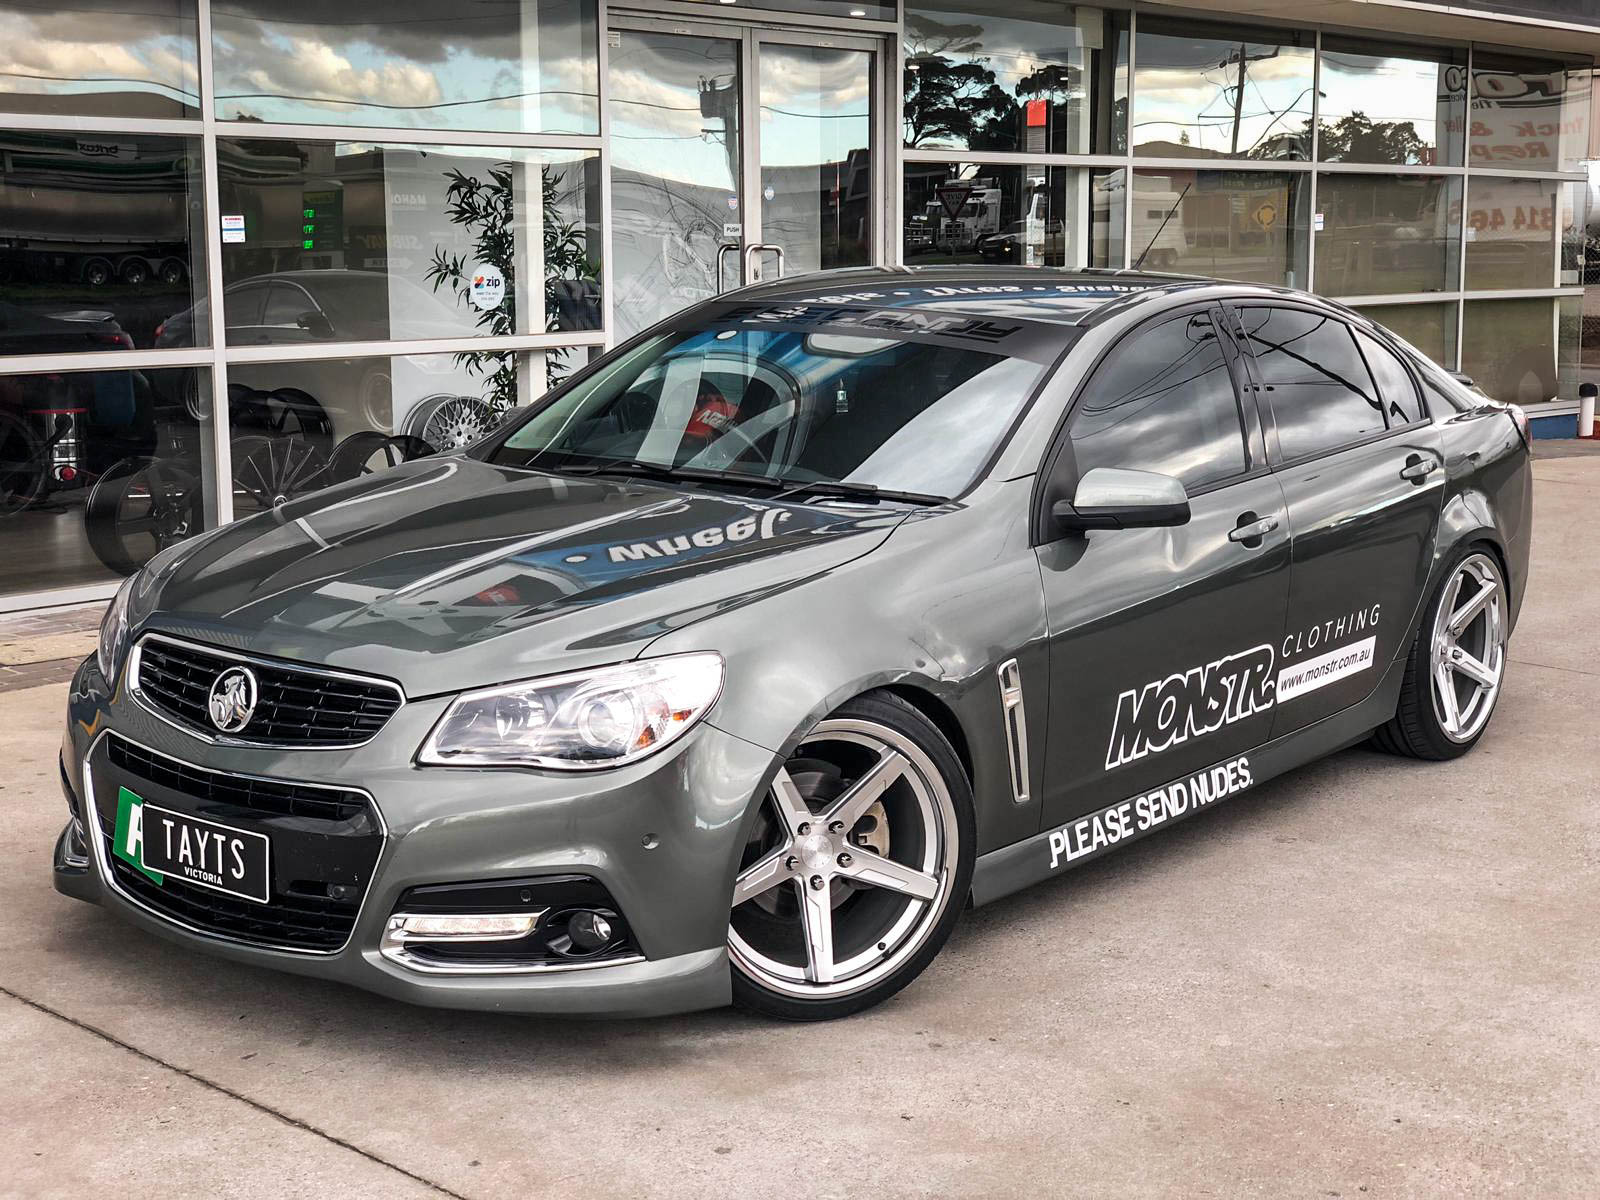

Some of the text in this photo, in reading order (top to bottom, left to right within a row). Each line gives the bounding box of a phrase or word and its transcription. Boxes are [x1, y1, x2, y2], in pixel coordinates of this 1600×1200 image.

[486, 275, 500, 288] zip
[1282, 604, 1381, 658] CLOTHING
[1281, 648, 1371, 692] www.monstr.com.au
[1049, 757, 1254, 869] PLEASE SEND NUDES.
[162, 818, 245, 879] TAYTS
[184, 866, 223, 886] VICTORIA
